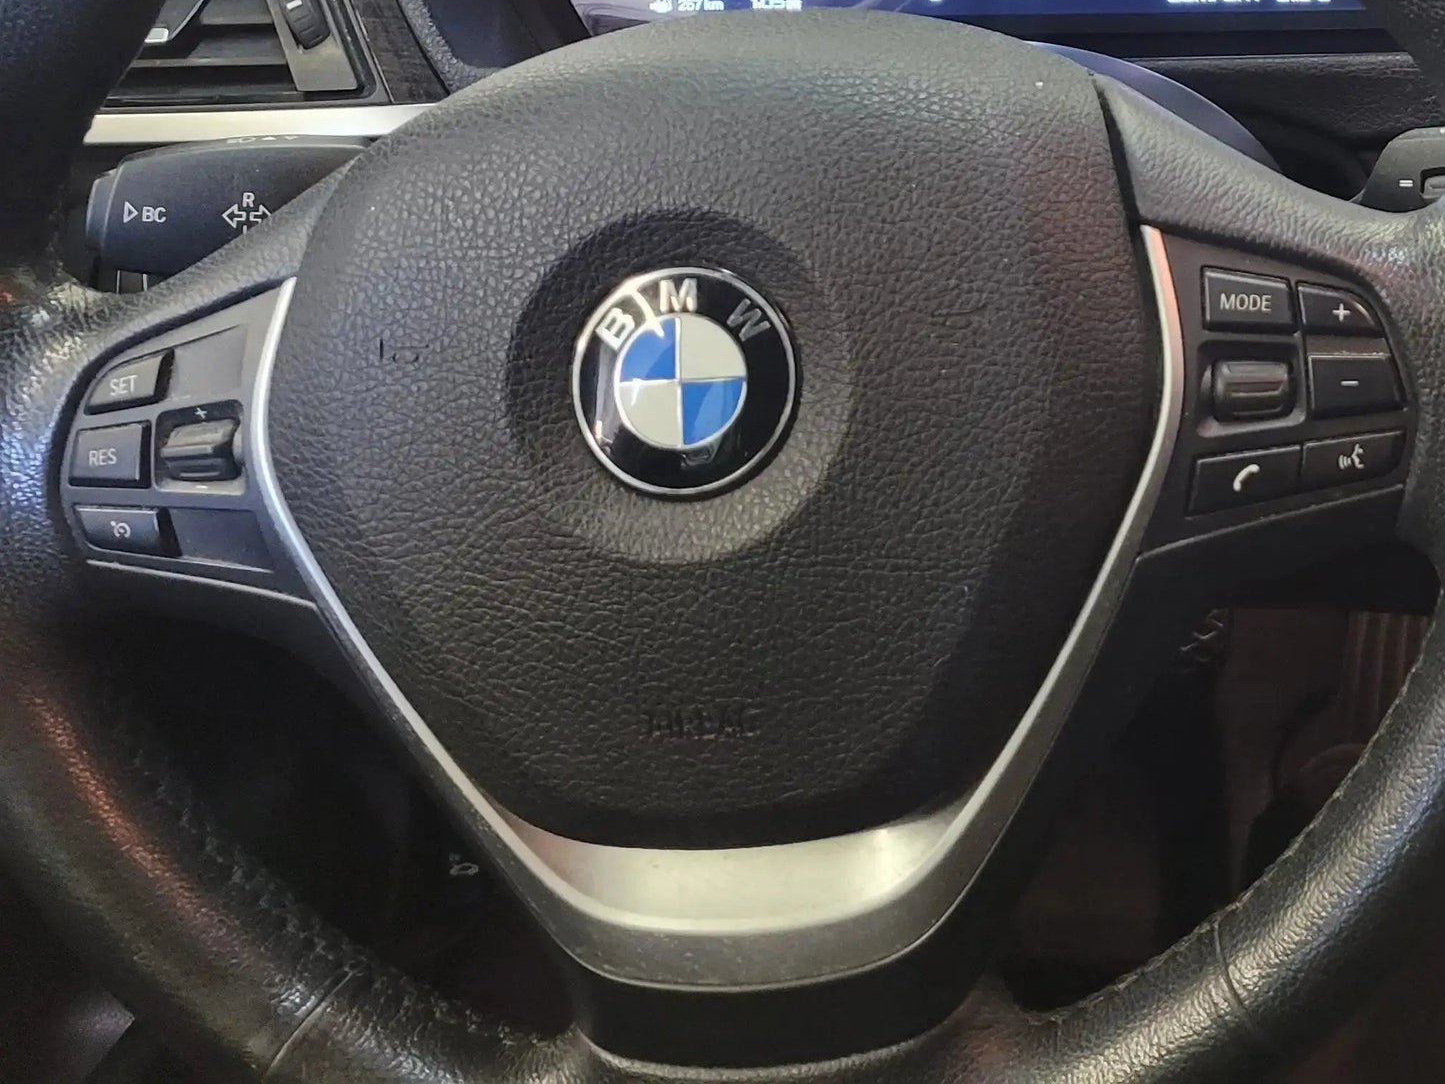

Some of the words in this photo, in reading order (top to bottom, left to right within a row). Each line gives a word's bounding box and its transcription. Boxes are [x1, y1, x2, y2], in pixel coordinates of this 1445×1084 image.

[242, 191, 255, 207] R
[142, 207, 166, 223] BC
[1220, 293, 1272, 312] MODE
[596, 278, 771, 351] BMW
[109, 374, 138, 395] SET
[88, 448, 117, 465] RES
